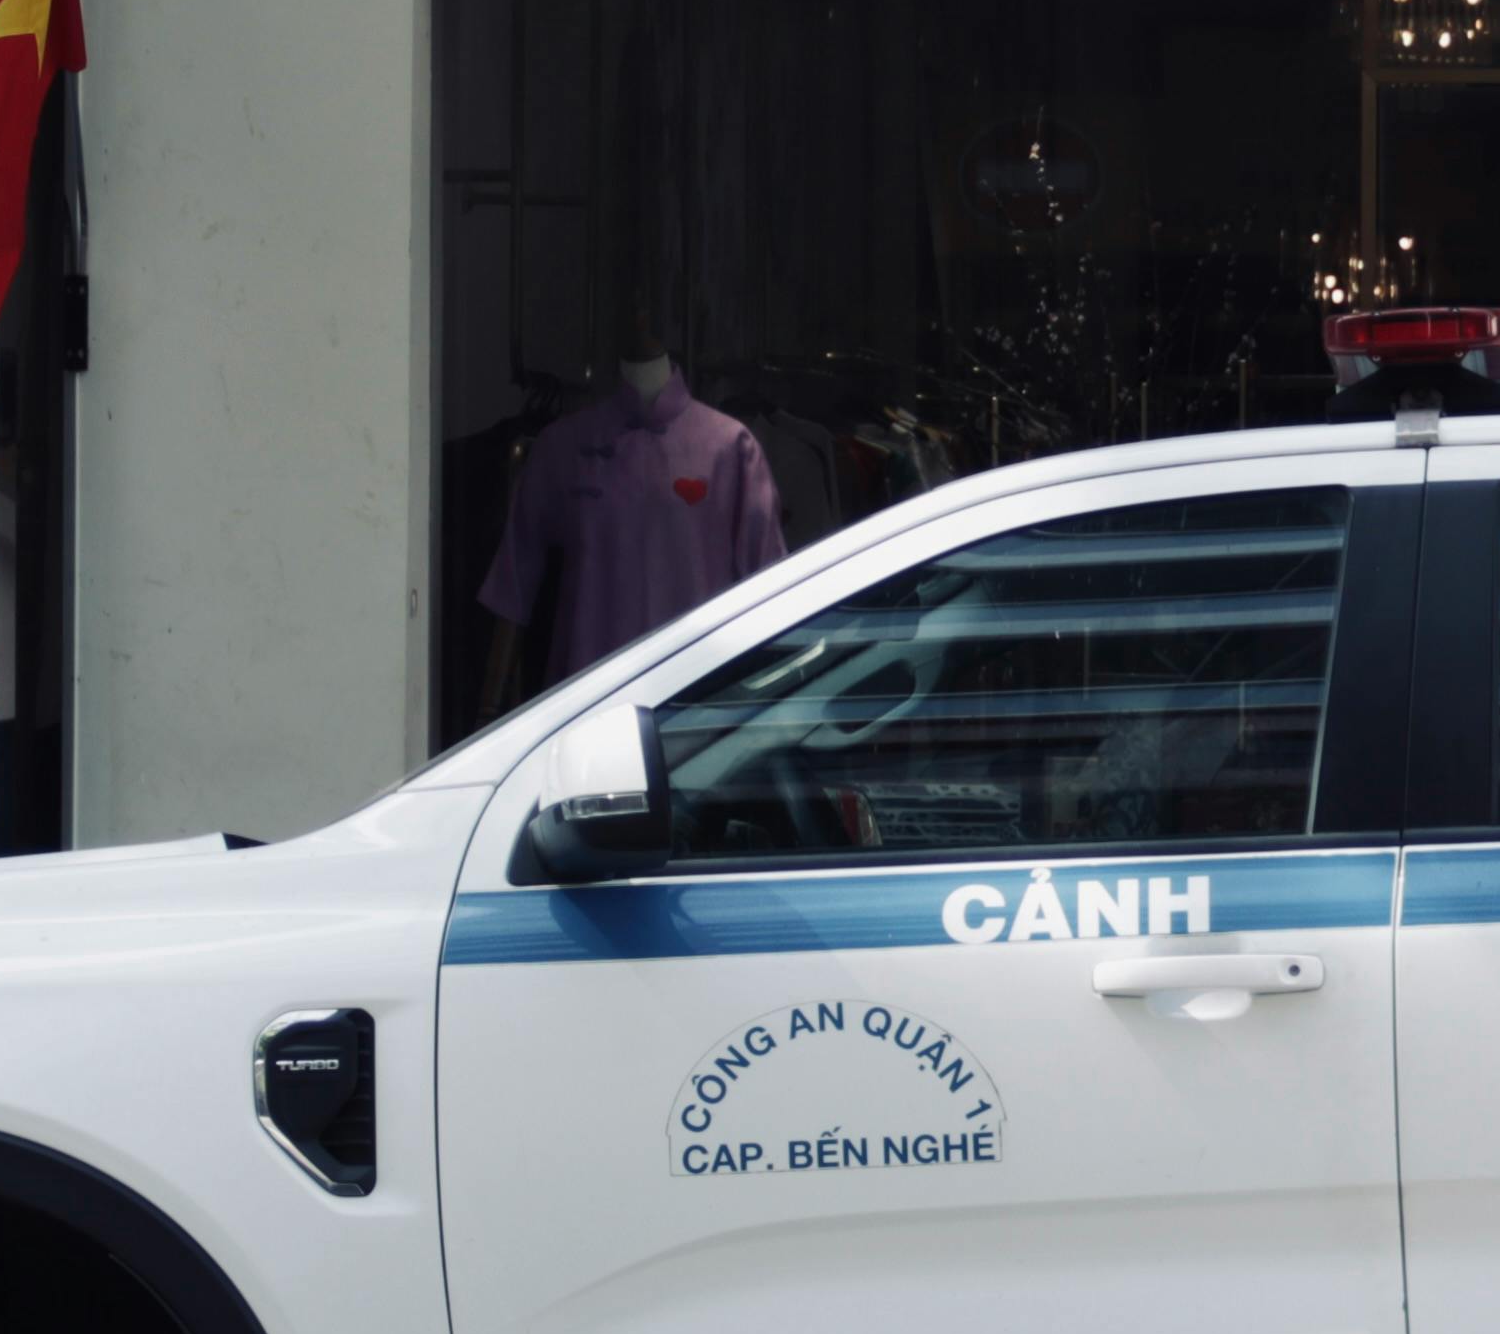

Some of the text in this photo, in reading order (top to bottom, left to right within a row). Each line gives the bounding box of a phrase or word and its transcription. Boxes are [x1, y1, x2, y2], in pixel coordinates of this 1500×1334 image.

[941, 866, 1211, 944] CẢNH
[680, 1001, 993, 1134] CÔNG AN QUẬN 1
[682, 1123, 996, 1175] CAP. BẾN NGHÉ
